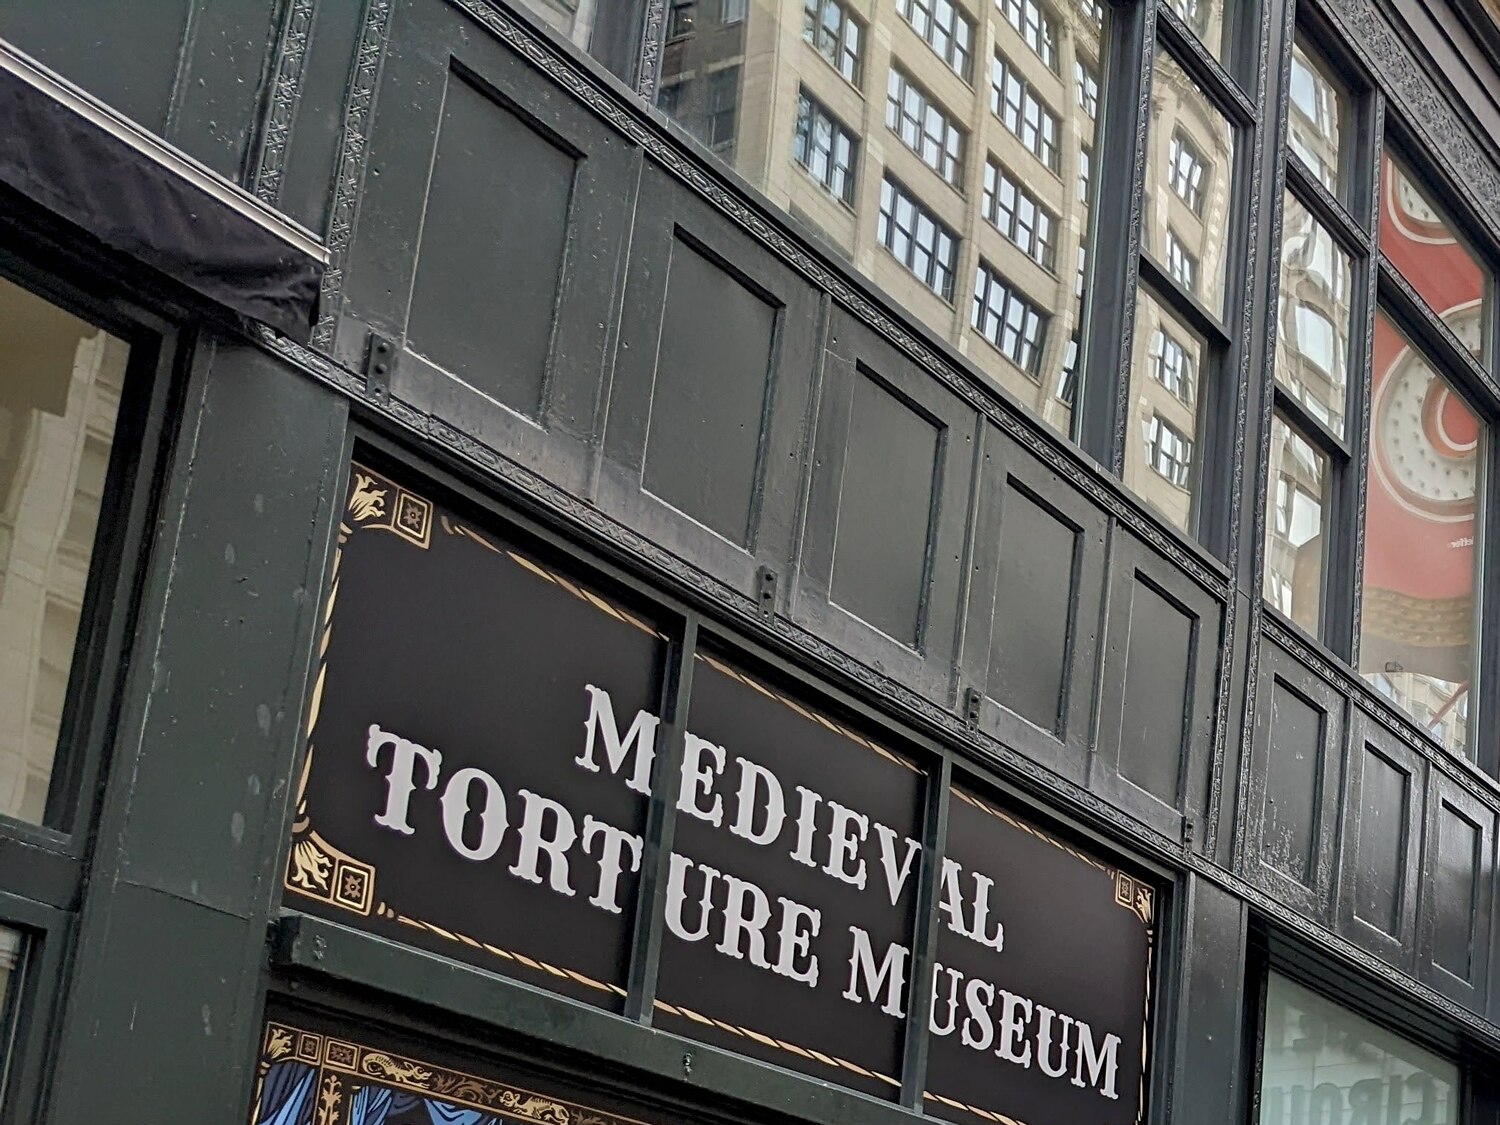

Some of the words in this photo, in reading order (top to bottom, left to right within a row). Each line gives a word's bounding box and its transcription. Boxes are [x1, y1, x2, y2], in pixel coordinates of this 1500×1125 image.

[366, 723, 822, 988] TORTURE
[842, 925, 1122, 1100] MUSEUM
[575, 683, 1004, 953] MEDIEVAL
